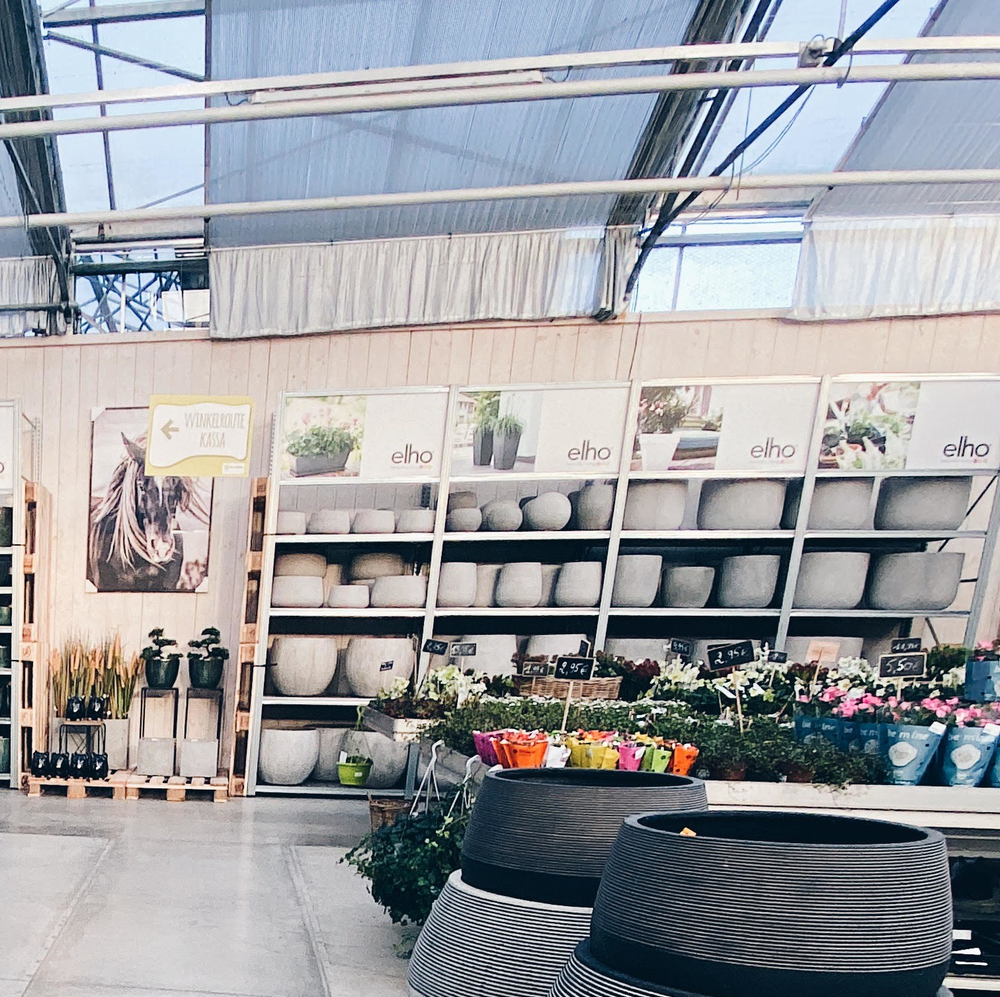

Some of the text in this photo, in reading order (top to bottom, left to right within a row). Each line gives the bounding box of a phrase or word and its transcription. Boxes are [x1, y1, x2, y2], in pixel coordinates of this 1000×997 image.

[184, 412, 245, 429] WINKELROUTE
[199, 432, 226, 448] KASSA
[750, 437, 796, 459] elho
[943, 435, 990, 458] elho
[391, 443, 433, 464] elho
[568, 440, 611, 461] elho
[558, 661, 588, 676] 2,95€
[886, 657, 918, 674] 5,50€
